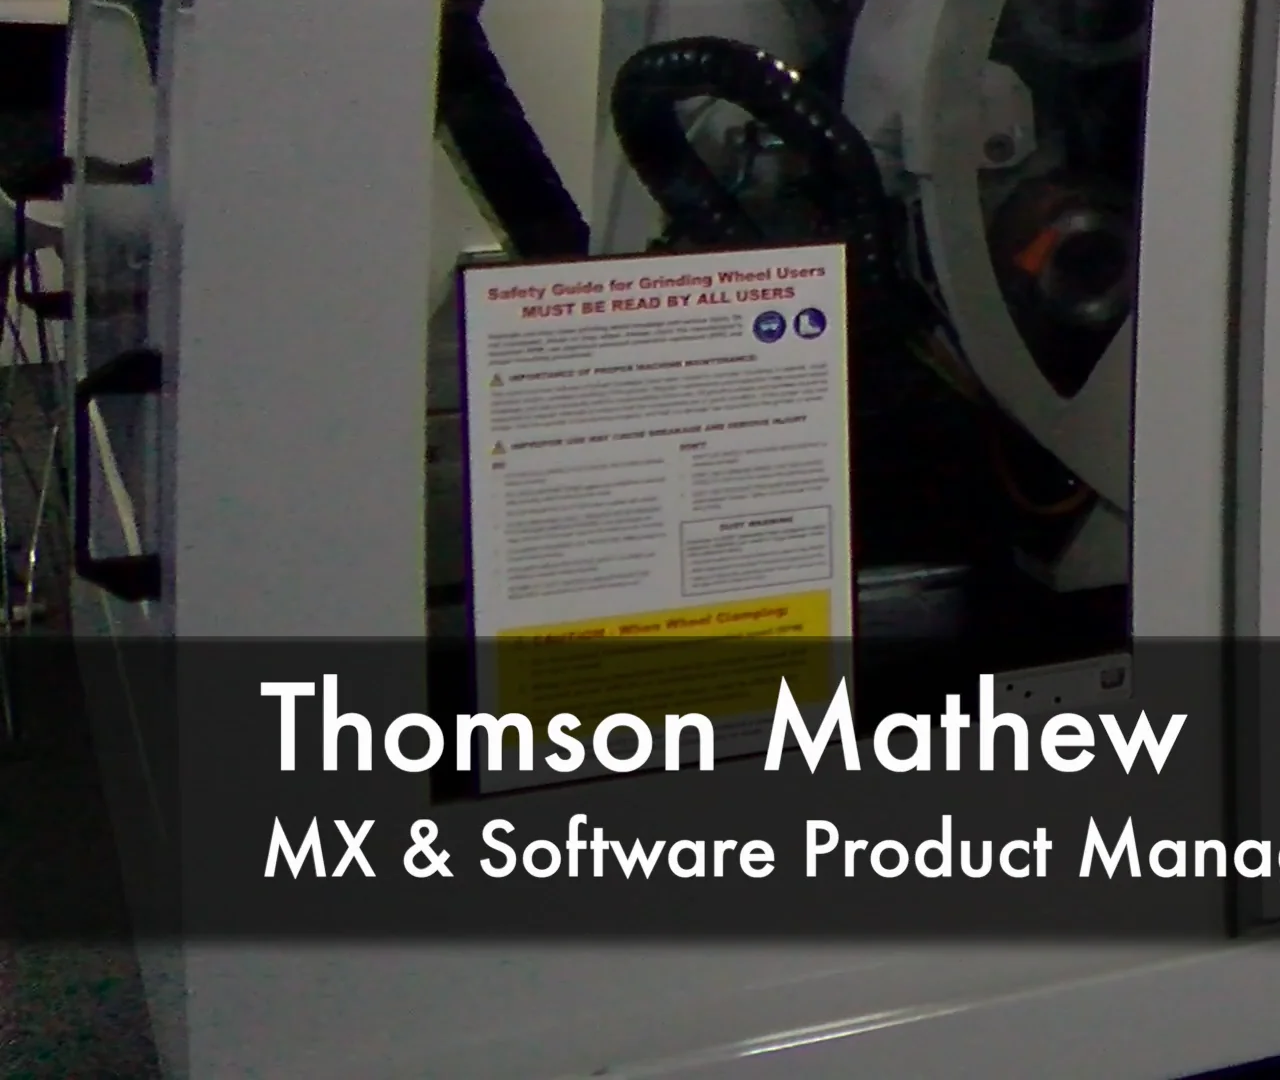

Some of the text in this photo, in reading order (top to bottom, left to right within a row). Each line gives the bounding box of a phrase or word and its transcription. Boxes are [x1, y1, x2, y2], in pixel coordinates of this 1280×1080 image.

[487, 266, 826, 300] Safety Guide for Grinding Wheel Users
[521, 286, 795, 318] MUST BE READ BY ALL USERS
